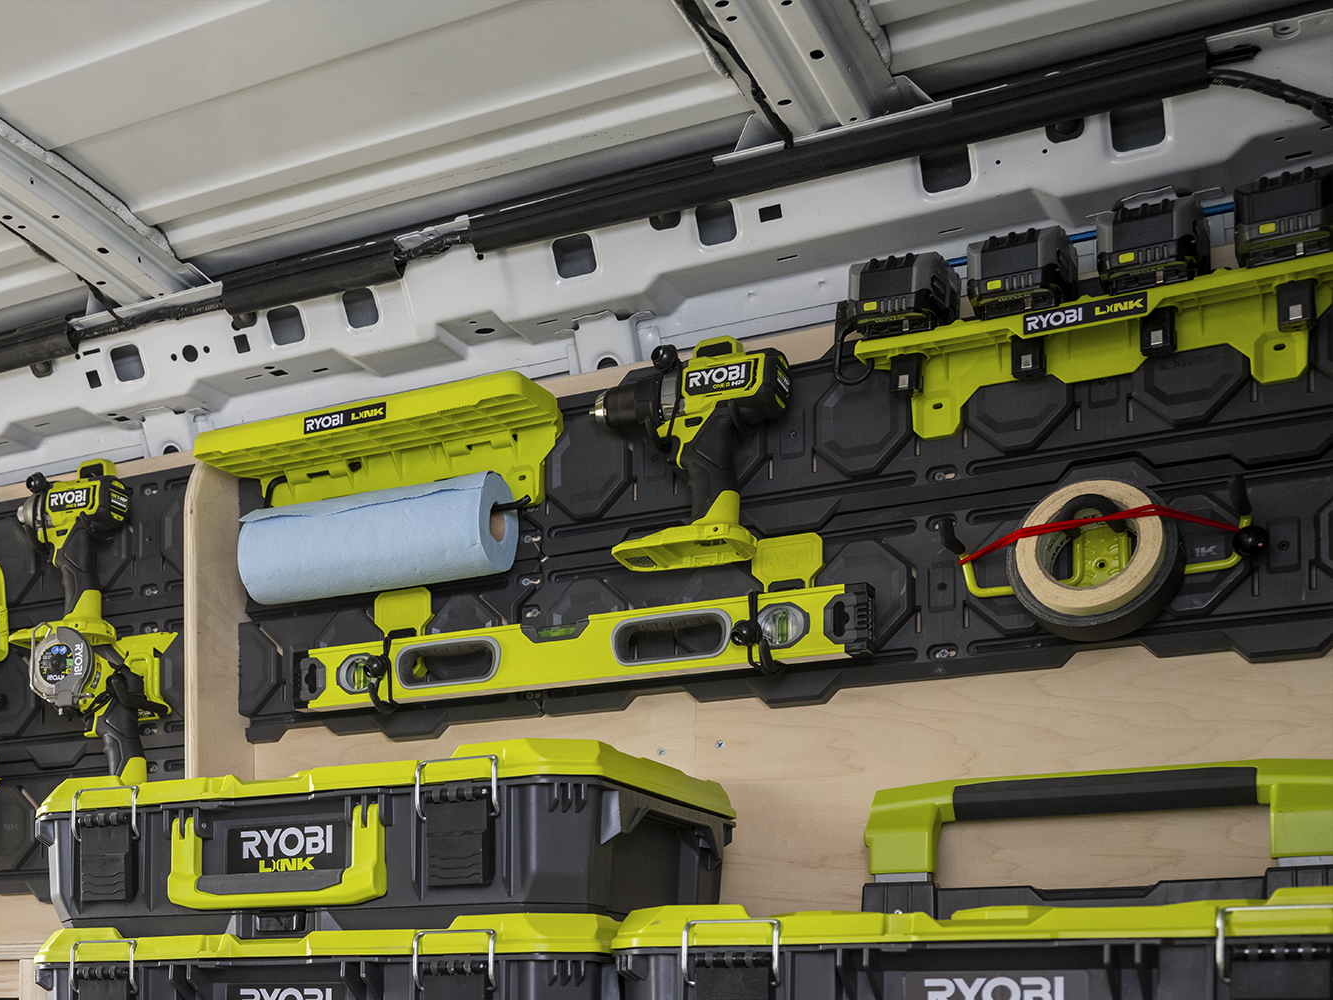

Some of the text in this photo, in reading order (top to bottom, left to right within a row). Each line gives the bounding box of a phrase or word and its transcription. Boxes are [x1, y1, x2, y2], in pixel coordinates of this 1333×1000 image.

[1026, 307, 1083, 331] RYOBI
[689, 364, 746, 388] RYOBI
[306, 413, 344, 431] RYOBI
[50, 489, 87, 507] RYOBI
[74, 643, 84, 676] RYOBI
[240, 824, 333, 859] RYOBI
